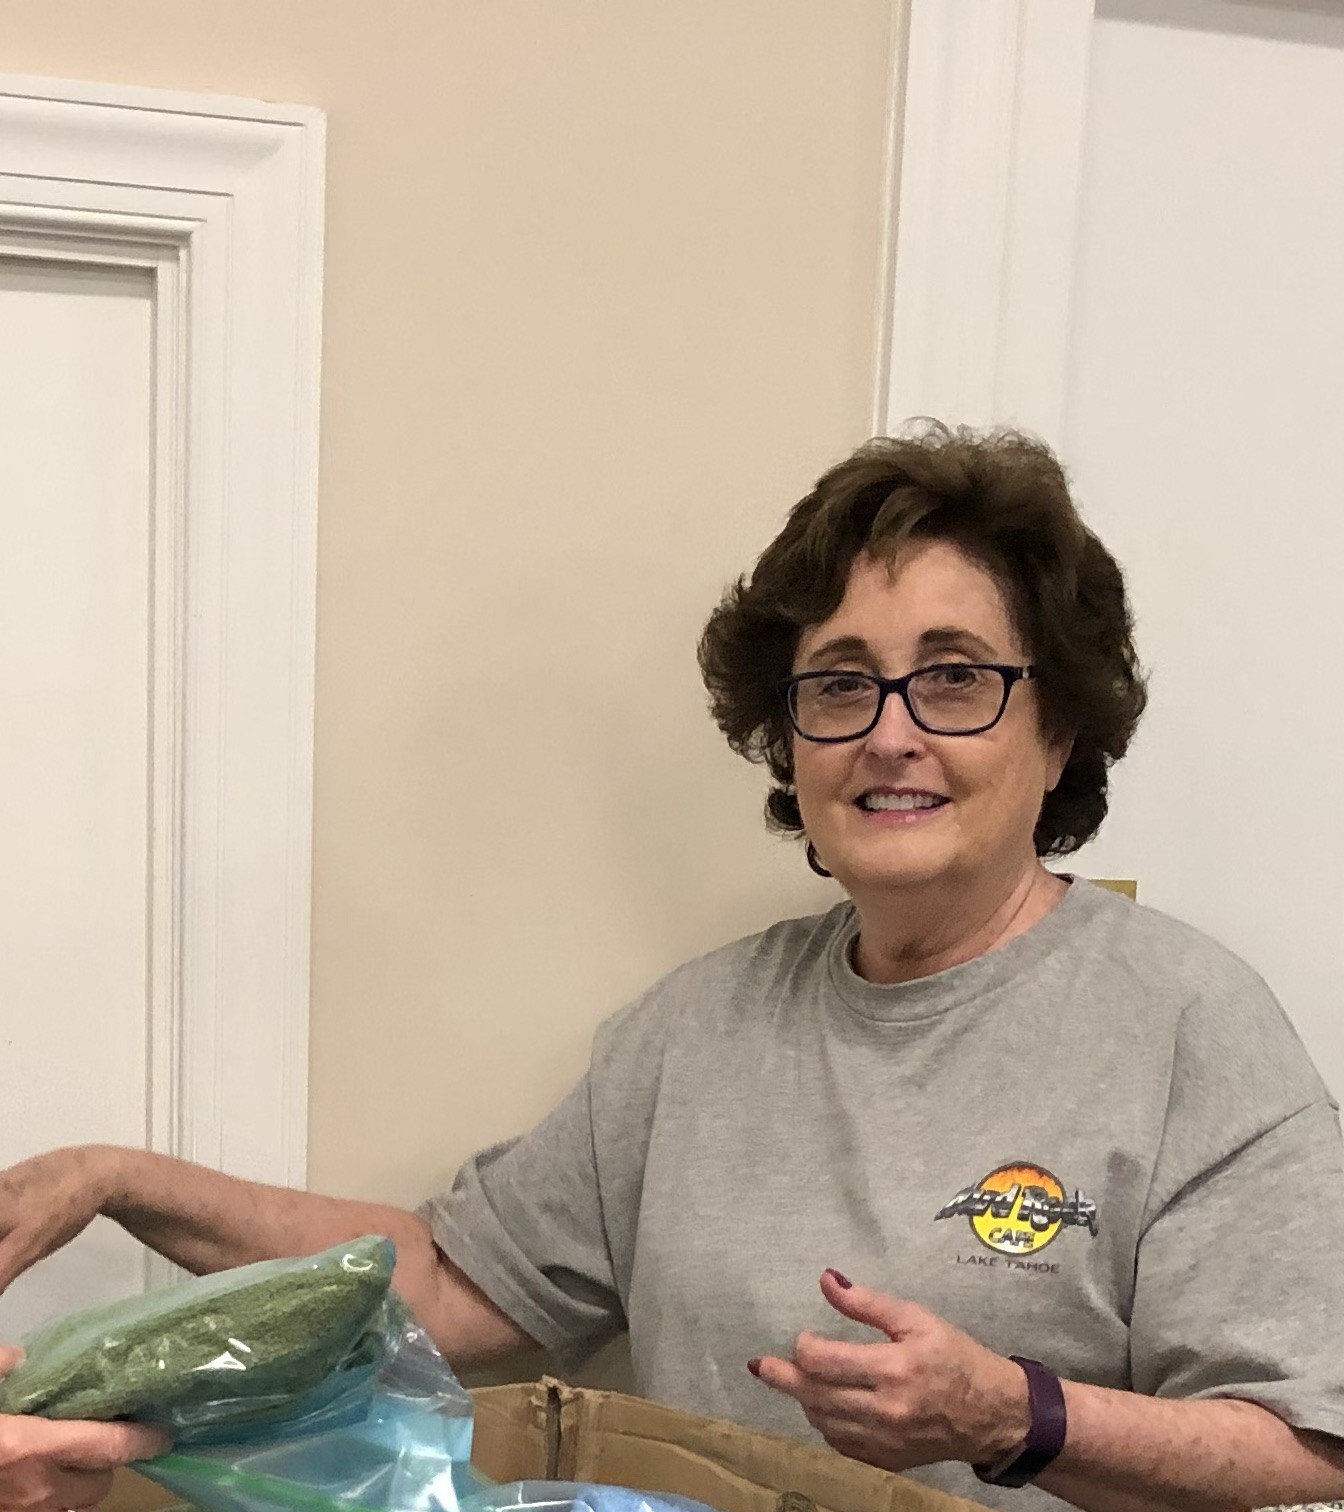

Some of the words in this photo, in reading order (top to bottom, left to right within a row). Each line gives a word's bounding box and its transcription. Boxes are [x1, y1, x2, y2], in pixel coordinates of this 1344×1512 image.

[988, 1227, 1036, 1248] CAFE
[956, 1255, 998, 1267] LAKE
[1007, 1260, 1061, 1274] TAHOE
